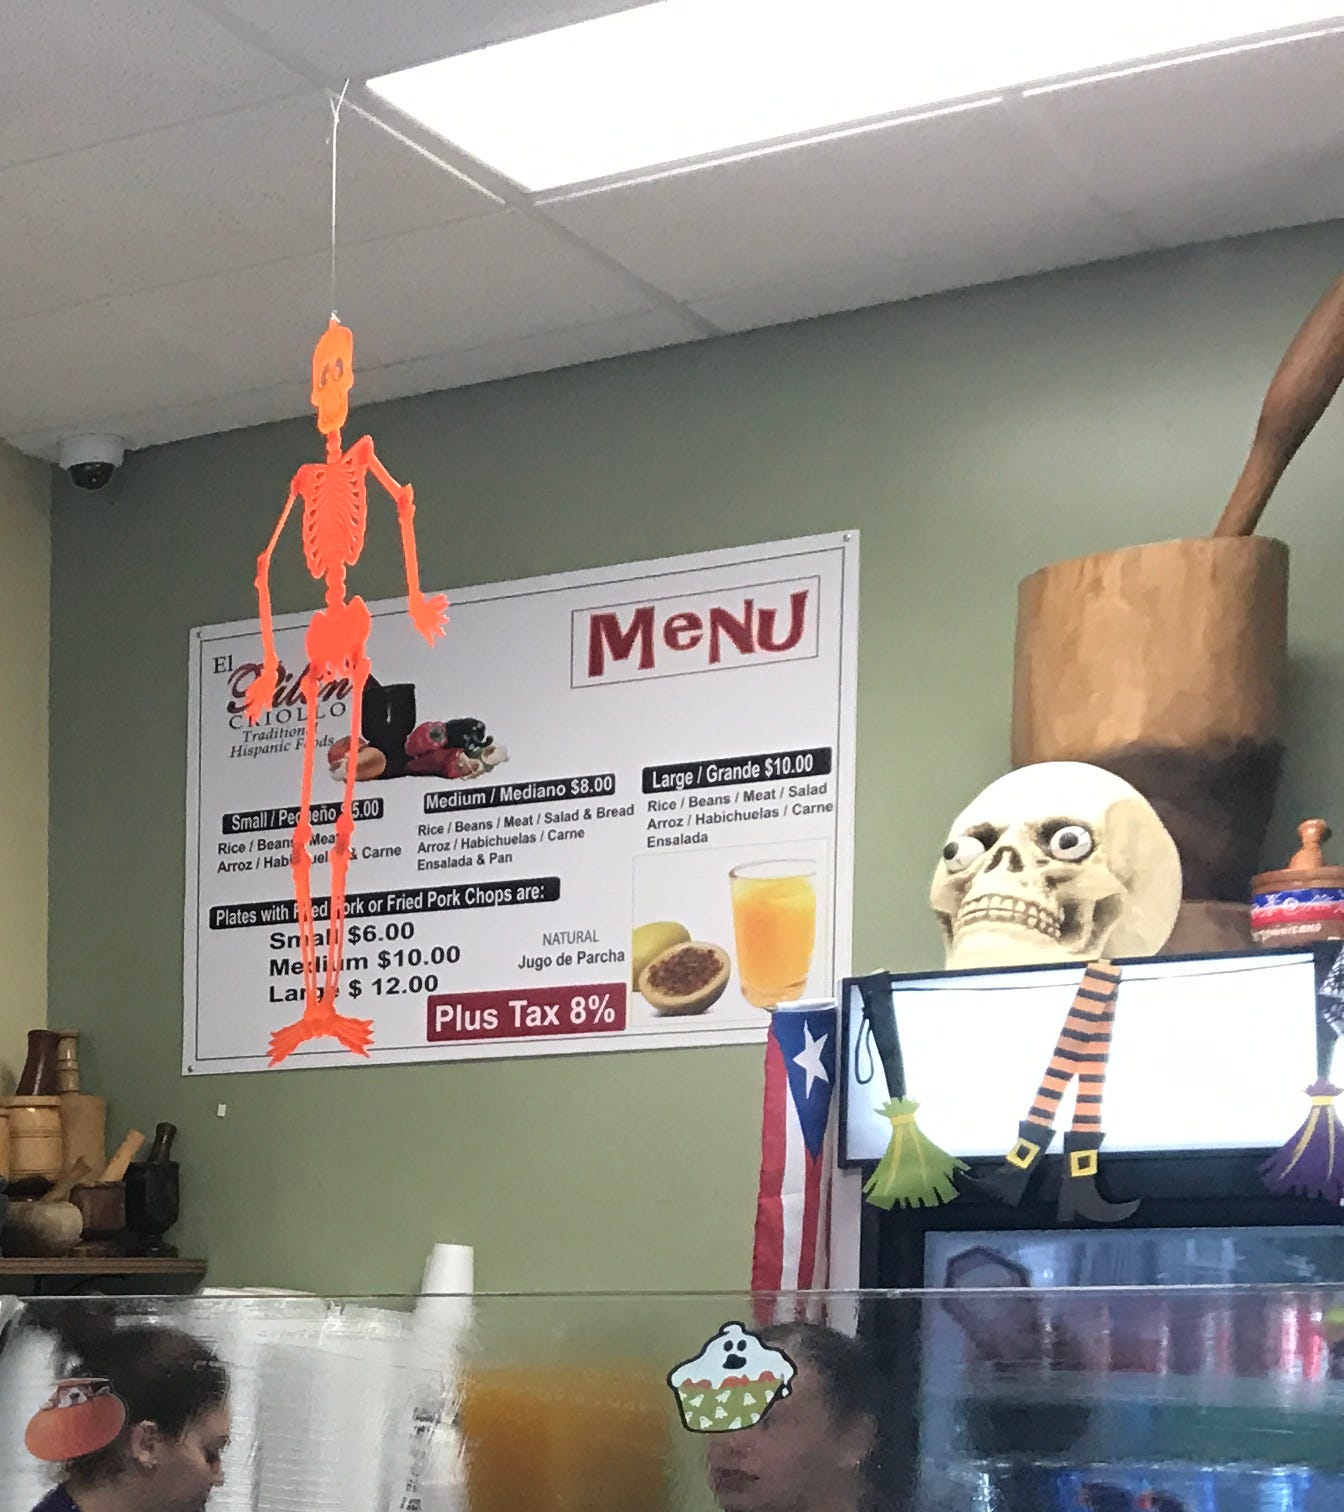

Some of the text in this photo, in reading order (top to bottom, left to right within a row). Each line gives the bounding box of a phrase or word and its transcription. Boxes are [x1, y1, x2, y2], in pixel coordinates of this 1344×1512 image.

[213, 654, 233, 674] El
[227, 660, 354, 714] Piln
[229, 739, 291, 759] Hispanic
[652, 770, 694, 791] Large
[706, 761, 761, 783] Grande
[764, 753, 814, 778] $10.00
[425, 791, 487, 810] Medium
[499, 782, 567, 802] Mediano
[570, 775, 613, 796] $8.00
[647, 800, 677, 813] Rice
[688, 795, 731, 808] Beans
[743, 788, 777, 803] Meat
[788, 782, 828, 798] Salad
[231, 809, 268, 831] Small
[417, 823, 445, 837] Rice
[455, 820, 493, 833] Beans
[503, 815, 534, 828] Meat
[544, 808, 580, 824] Salad
[583, 808, 592, 820] &
[596, 803, 635, 819] Bread
[647, 817, 684, 831] Arroz
[695, 807, 779, 826] Habichuelas
[792, 801, 834, 816] Carne
[217, 841, 247, 855] Rice
[417, 841, 451, 854] Arroz
[461, 832, 537, 850] Habichuelas
[547, 828, 586, 842] Carne
[647, 831, 709, 849] Ensalada
[217, 859, 253, 874] Arroz
[362, 845, 402, 861] Carne
[417, 852, 513, 871] Ensalada & Pan
[216, 908, 257, 926] Plates
[261, 905, 289, 922] with
[368, 899, 383, 914] or
[387, 892, 423, 911] Fried
[427, 891, 461, 909] Pork
[464, 886, 512, 907] Chops
[516, 884, 545, 901] are:
[347, 921, 415, 946] $6.00
[542, 929, 599, 947] NATURAL
[377, 945, 461, 970] $10.00
[517, 948, 625, 972] Jugo de Parcha
[348, 978, 363, 1000] $
[371, 974, 439, 996] 12.00
[434, 992, 616, 1033] Plus Tax 8%
